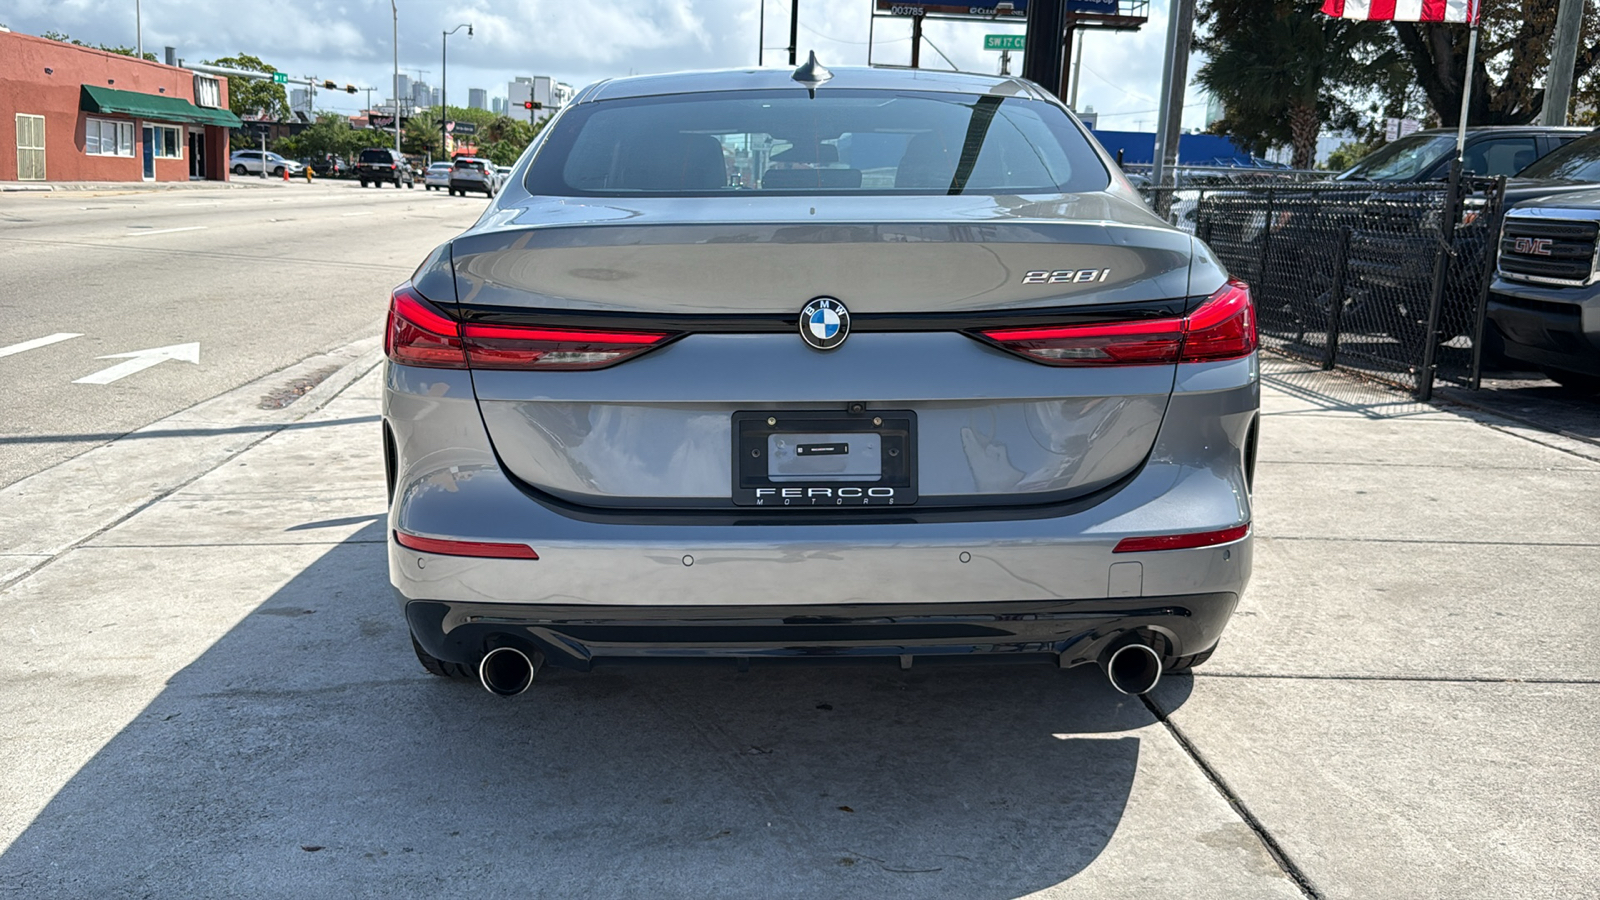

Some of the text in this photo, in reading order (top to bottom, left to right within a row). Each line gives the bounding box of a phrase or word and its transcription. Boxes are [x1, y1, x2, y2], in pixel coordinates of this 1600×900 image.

[891, 6, 924, 16] 003785
[988, 37, 1001, 47] SW
[1003, 37, 1013, 47] 17
[1515, 237, 1553, 255] GMC
[805, 300, 846, 316] BMW
[756, 487, 894, 498] FERCO
